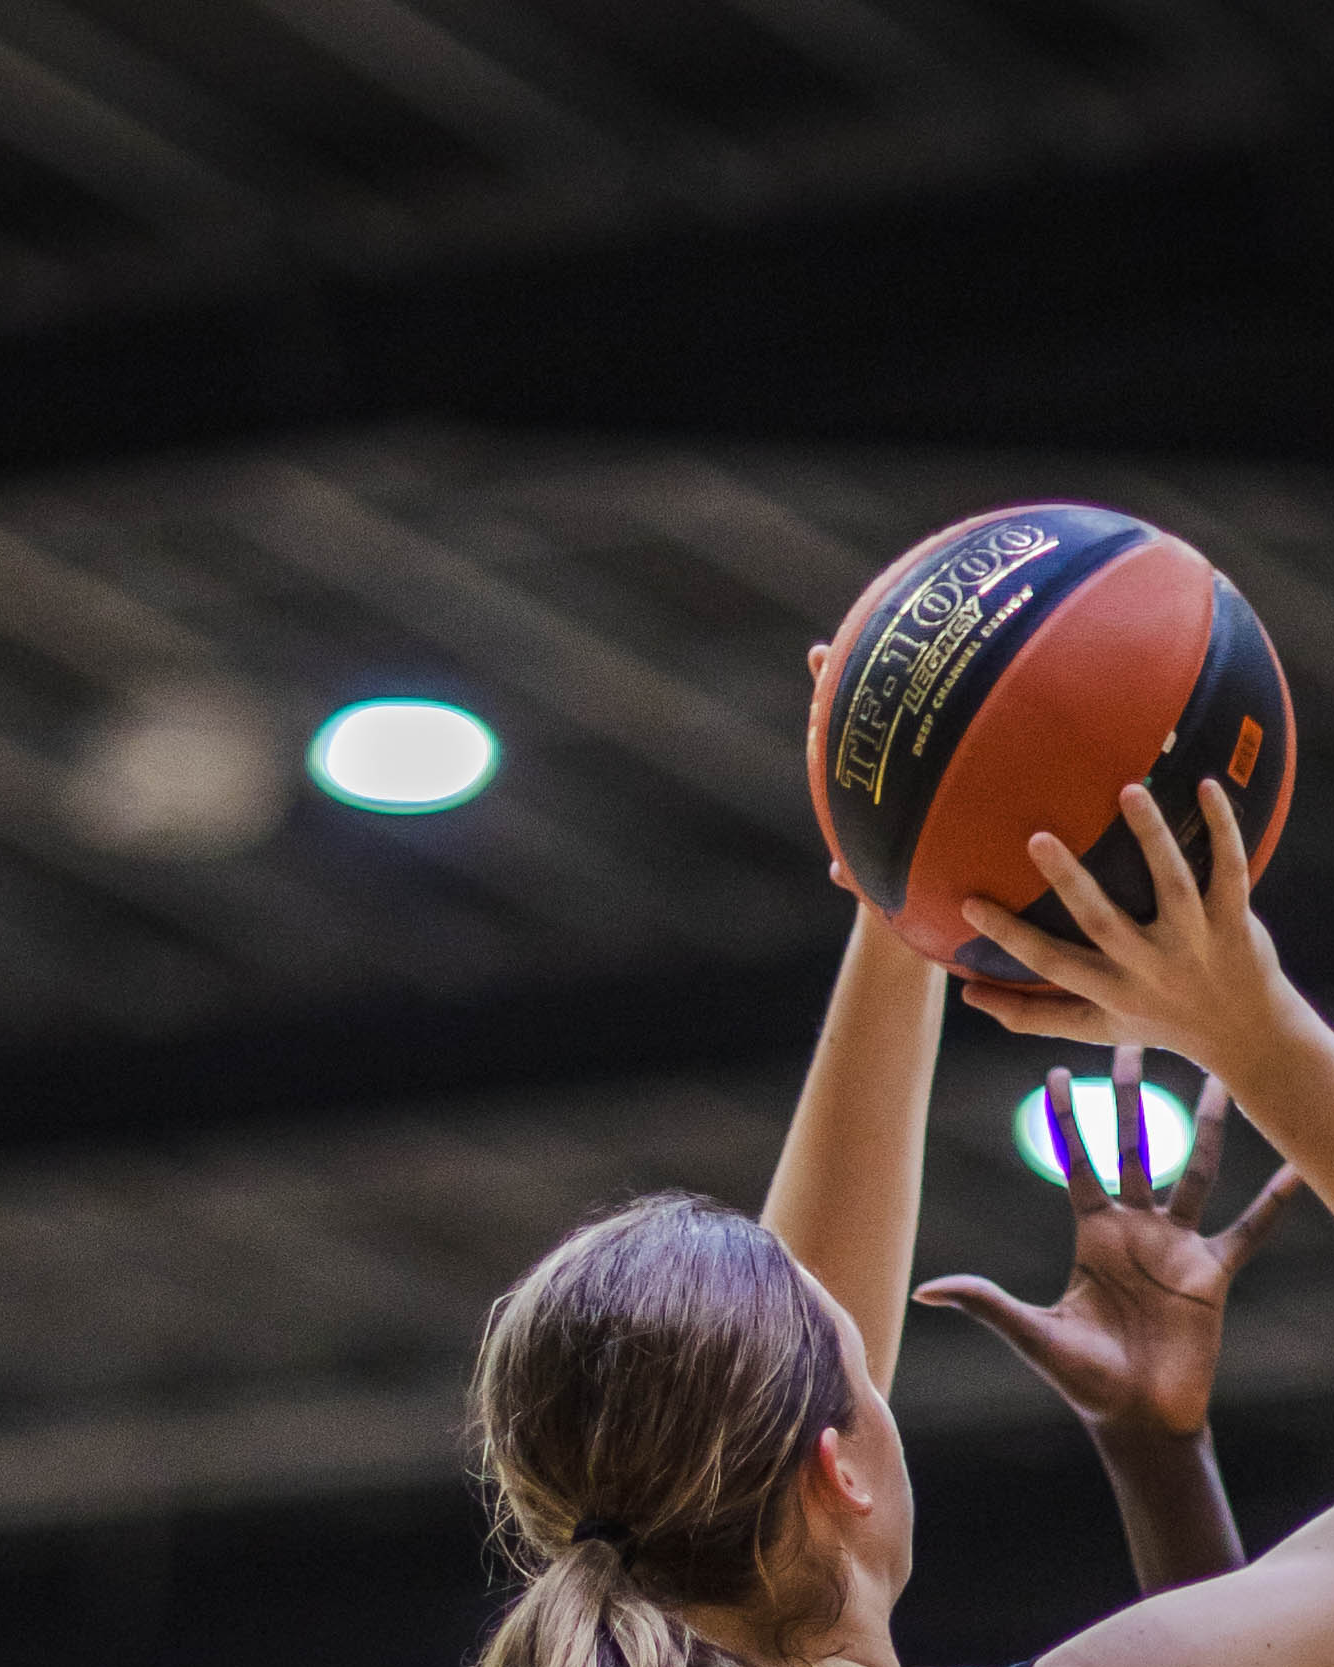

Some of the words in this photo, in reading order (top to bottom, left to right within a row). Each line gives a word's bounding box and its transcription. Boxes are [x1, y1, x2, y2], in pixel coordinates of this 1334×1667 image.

[840, 524, 1045, 791] TF-1000
[902, 594, 984, 716] LEGACY
[912, 713, 934, 757] DEEP
[931, 640, 982, 710] CHANNEL
[979, 584, 1034, 638] DESIGN
